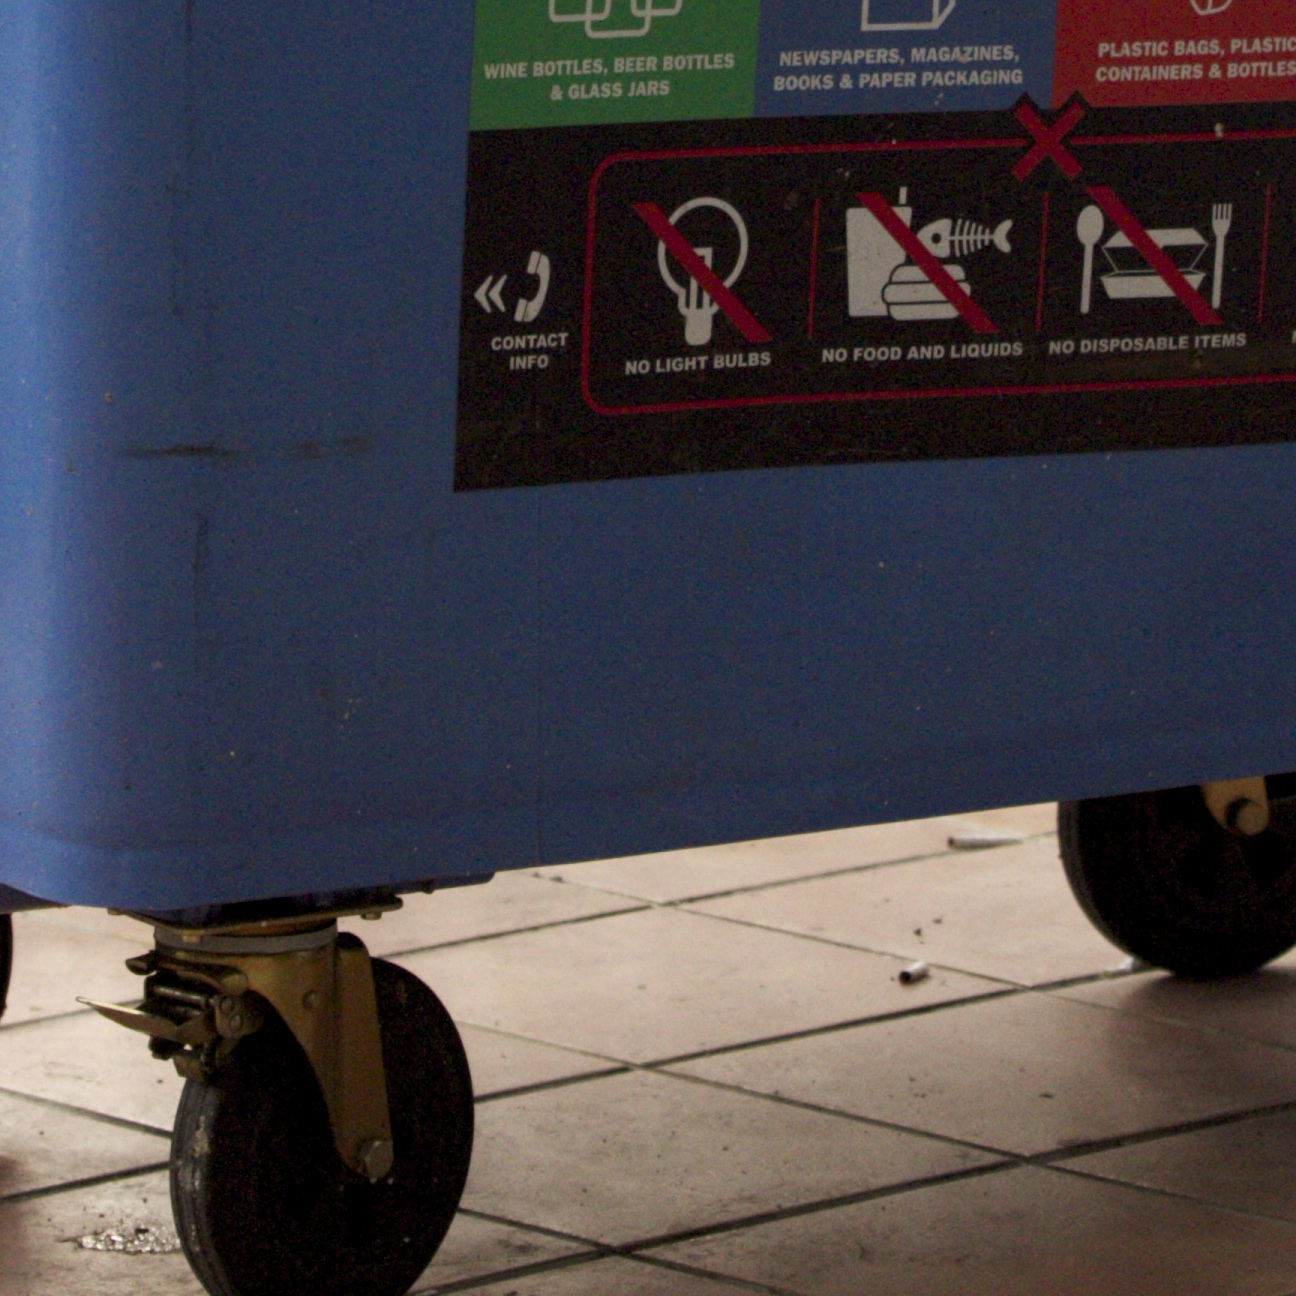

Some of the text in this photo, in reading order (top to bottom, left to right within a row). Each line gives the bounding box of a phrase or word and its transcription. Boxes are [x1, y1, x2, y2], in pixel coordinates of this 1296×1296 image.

[779, 44, 1020, 68] NEWSPAPERS, MAGAZINES,
[1098, 40, 1169, 58] PLASTIC
[1174, 39, 1225, 58] BAGS,
[484, 53, 735, 79] WINE BOTTLES, BEER BOTTLES
[1096, 64, 1205, 82] CONTAINERS
[1209, 62, 1223, 79] &
[550, 79, 670, 100] & GLASS JARS
[774, 68, 1023, 92] BOOKS & PAPER PACKAGING
[491, 333, 568, 353] CONTACT
[821, 342, 1023, 363] NO FOOD AND LIQUIDS
[1049, 332, 1247, 355] NO DISPOSABLE ITEMS
[509, 354, 549, 370] INFO
[624, 352, 771, 376] NO LIGHT BULBS
